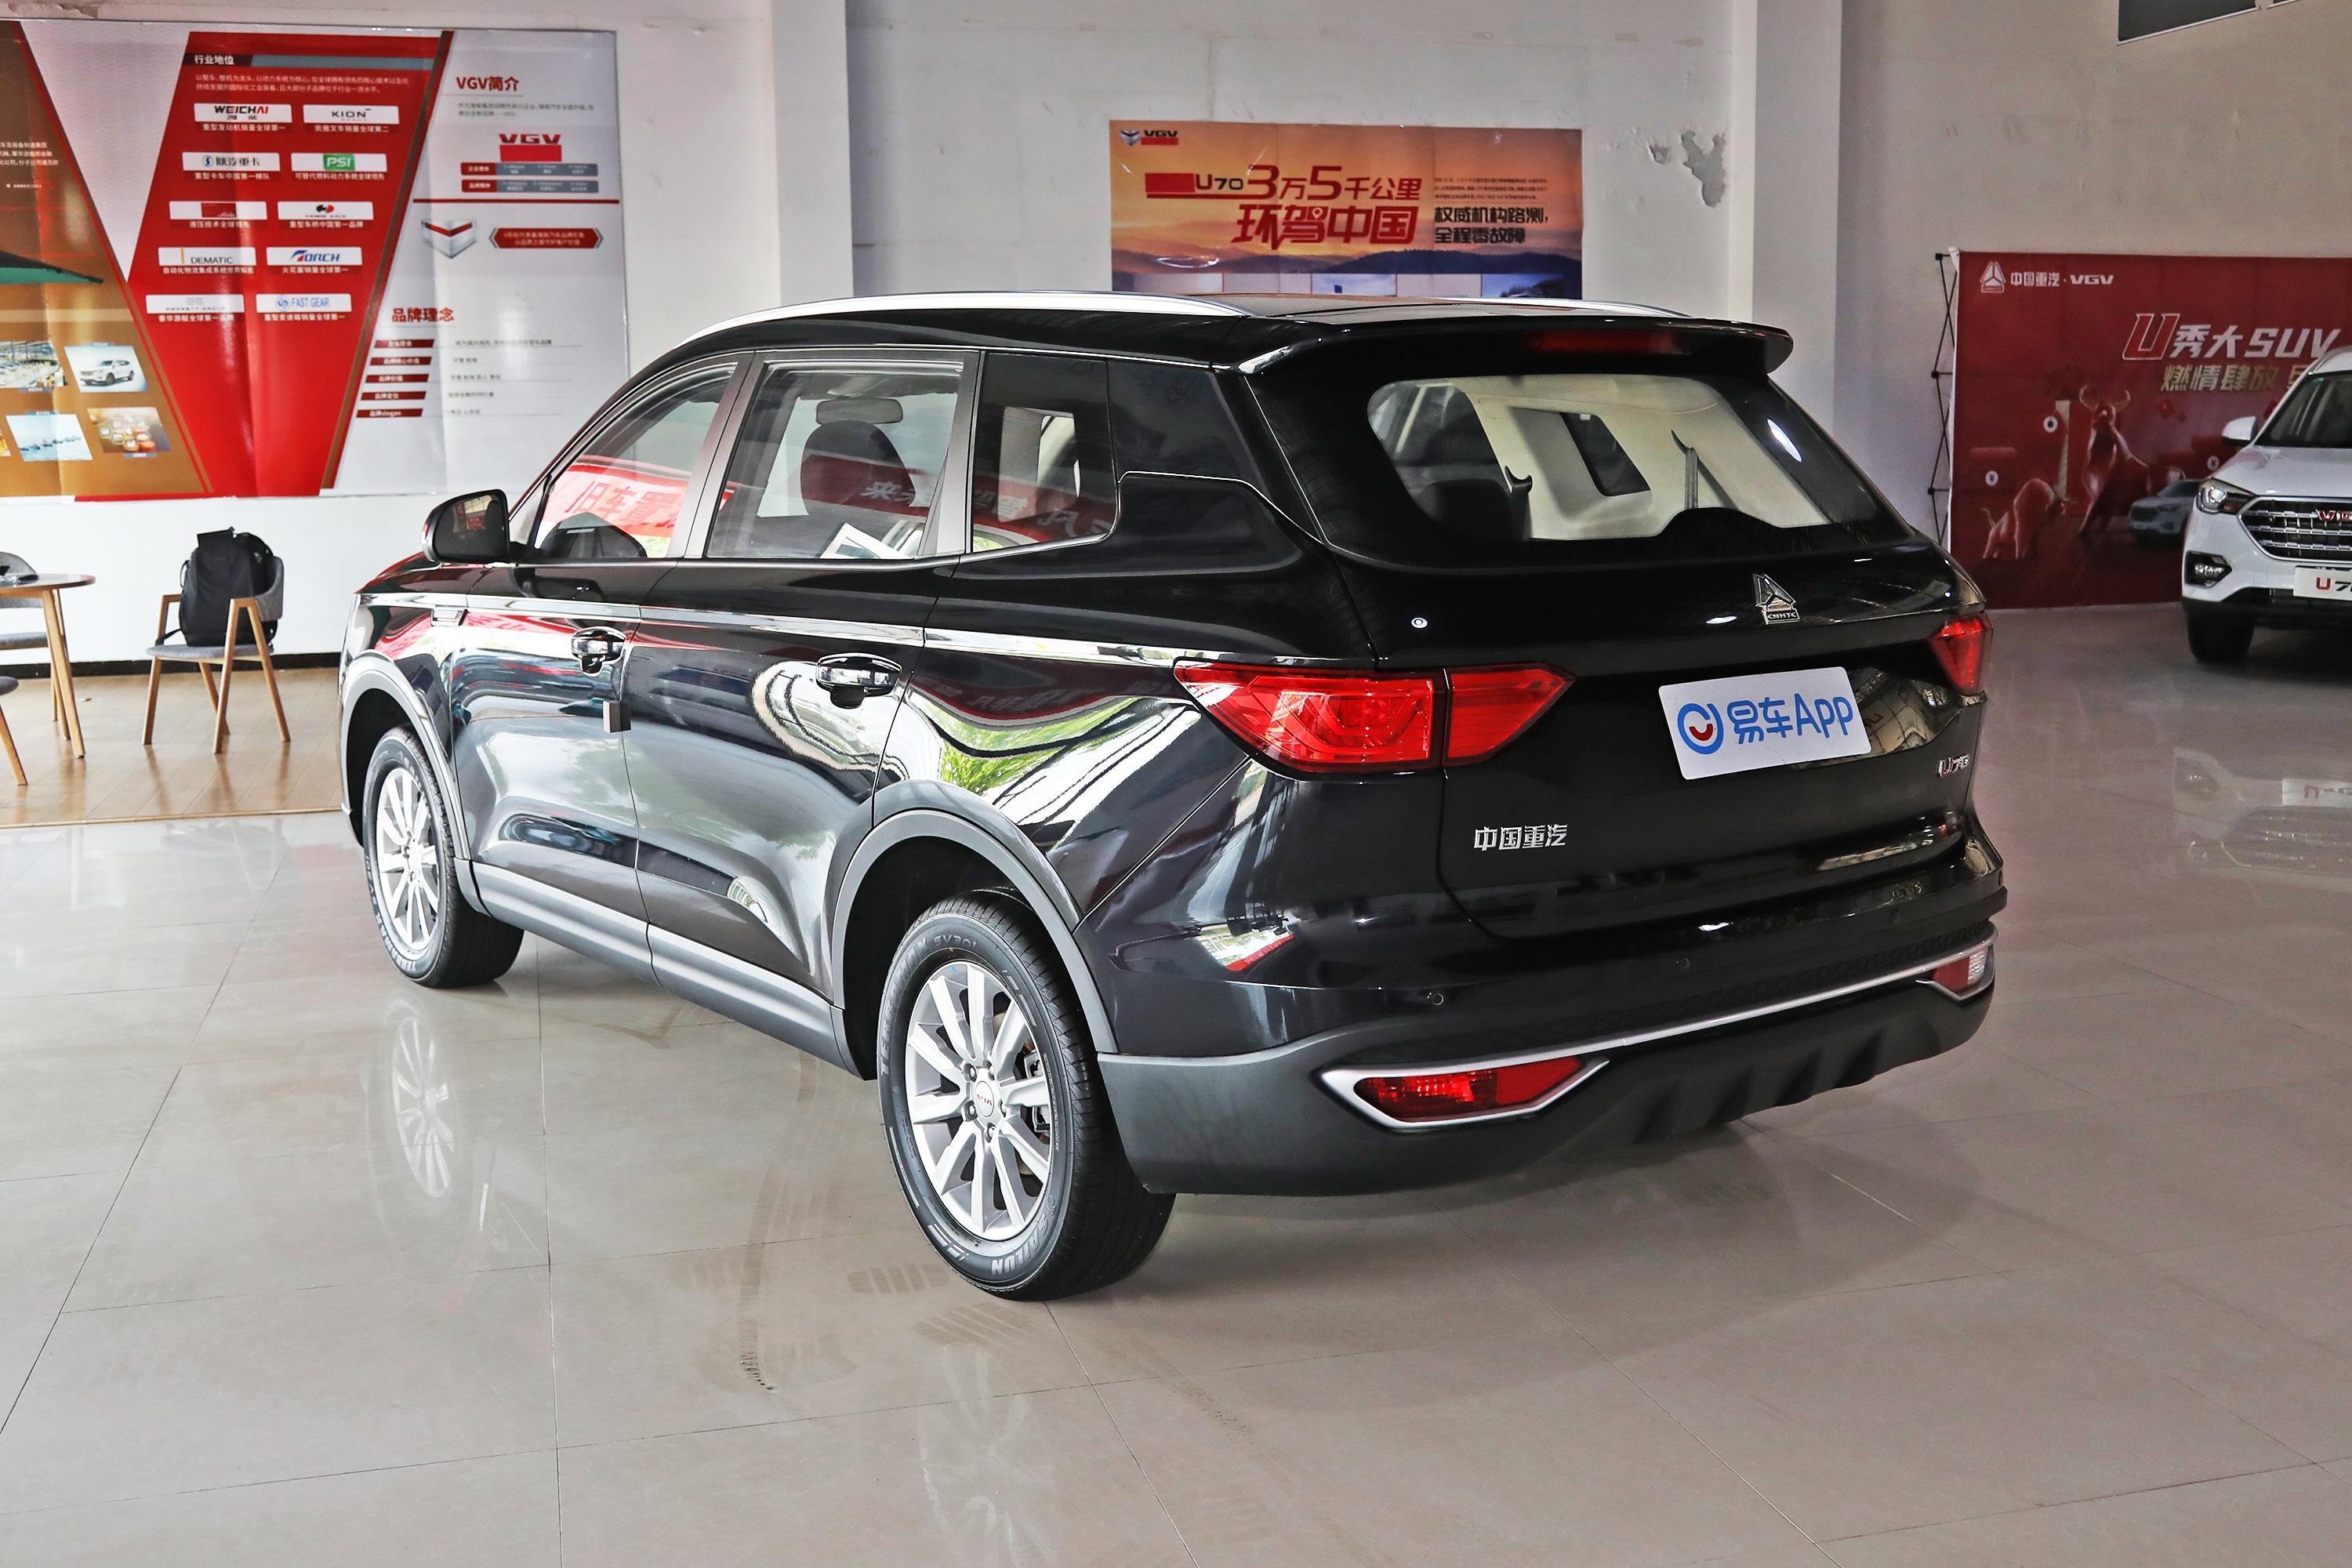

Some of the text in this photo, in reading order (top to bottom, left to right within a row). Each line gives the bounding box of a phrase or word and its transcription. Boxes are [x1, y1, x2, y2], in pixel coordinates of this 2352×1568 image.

[194, 55, 235, 65] 行业地位
[456, 76, 520, 92] VGV简介
[499, 133, 561, 144] VGV
[326, 157, 351, 168] PSI
[1196, 173, 1244, 191] U70
[1231, 204, 1419, 250] 环驾中国
[1435, 227, 1526, 244] 全程零故障
[191, 256, 234, 265] DEMATIC
[292, 297, 330, 307] FAST GEAR
[392, 307, 455, 323] 品牌理念
[1726, 693, 1853, 745] 易车App
[1474, 824, 1568, 851] 中国重汽
